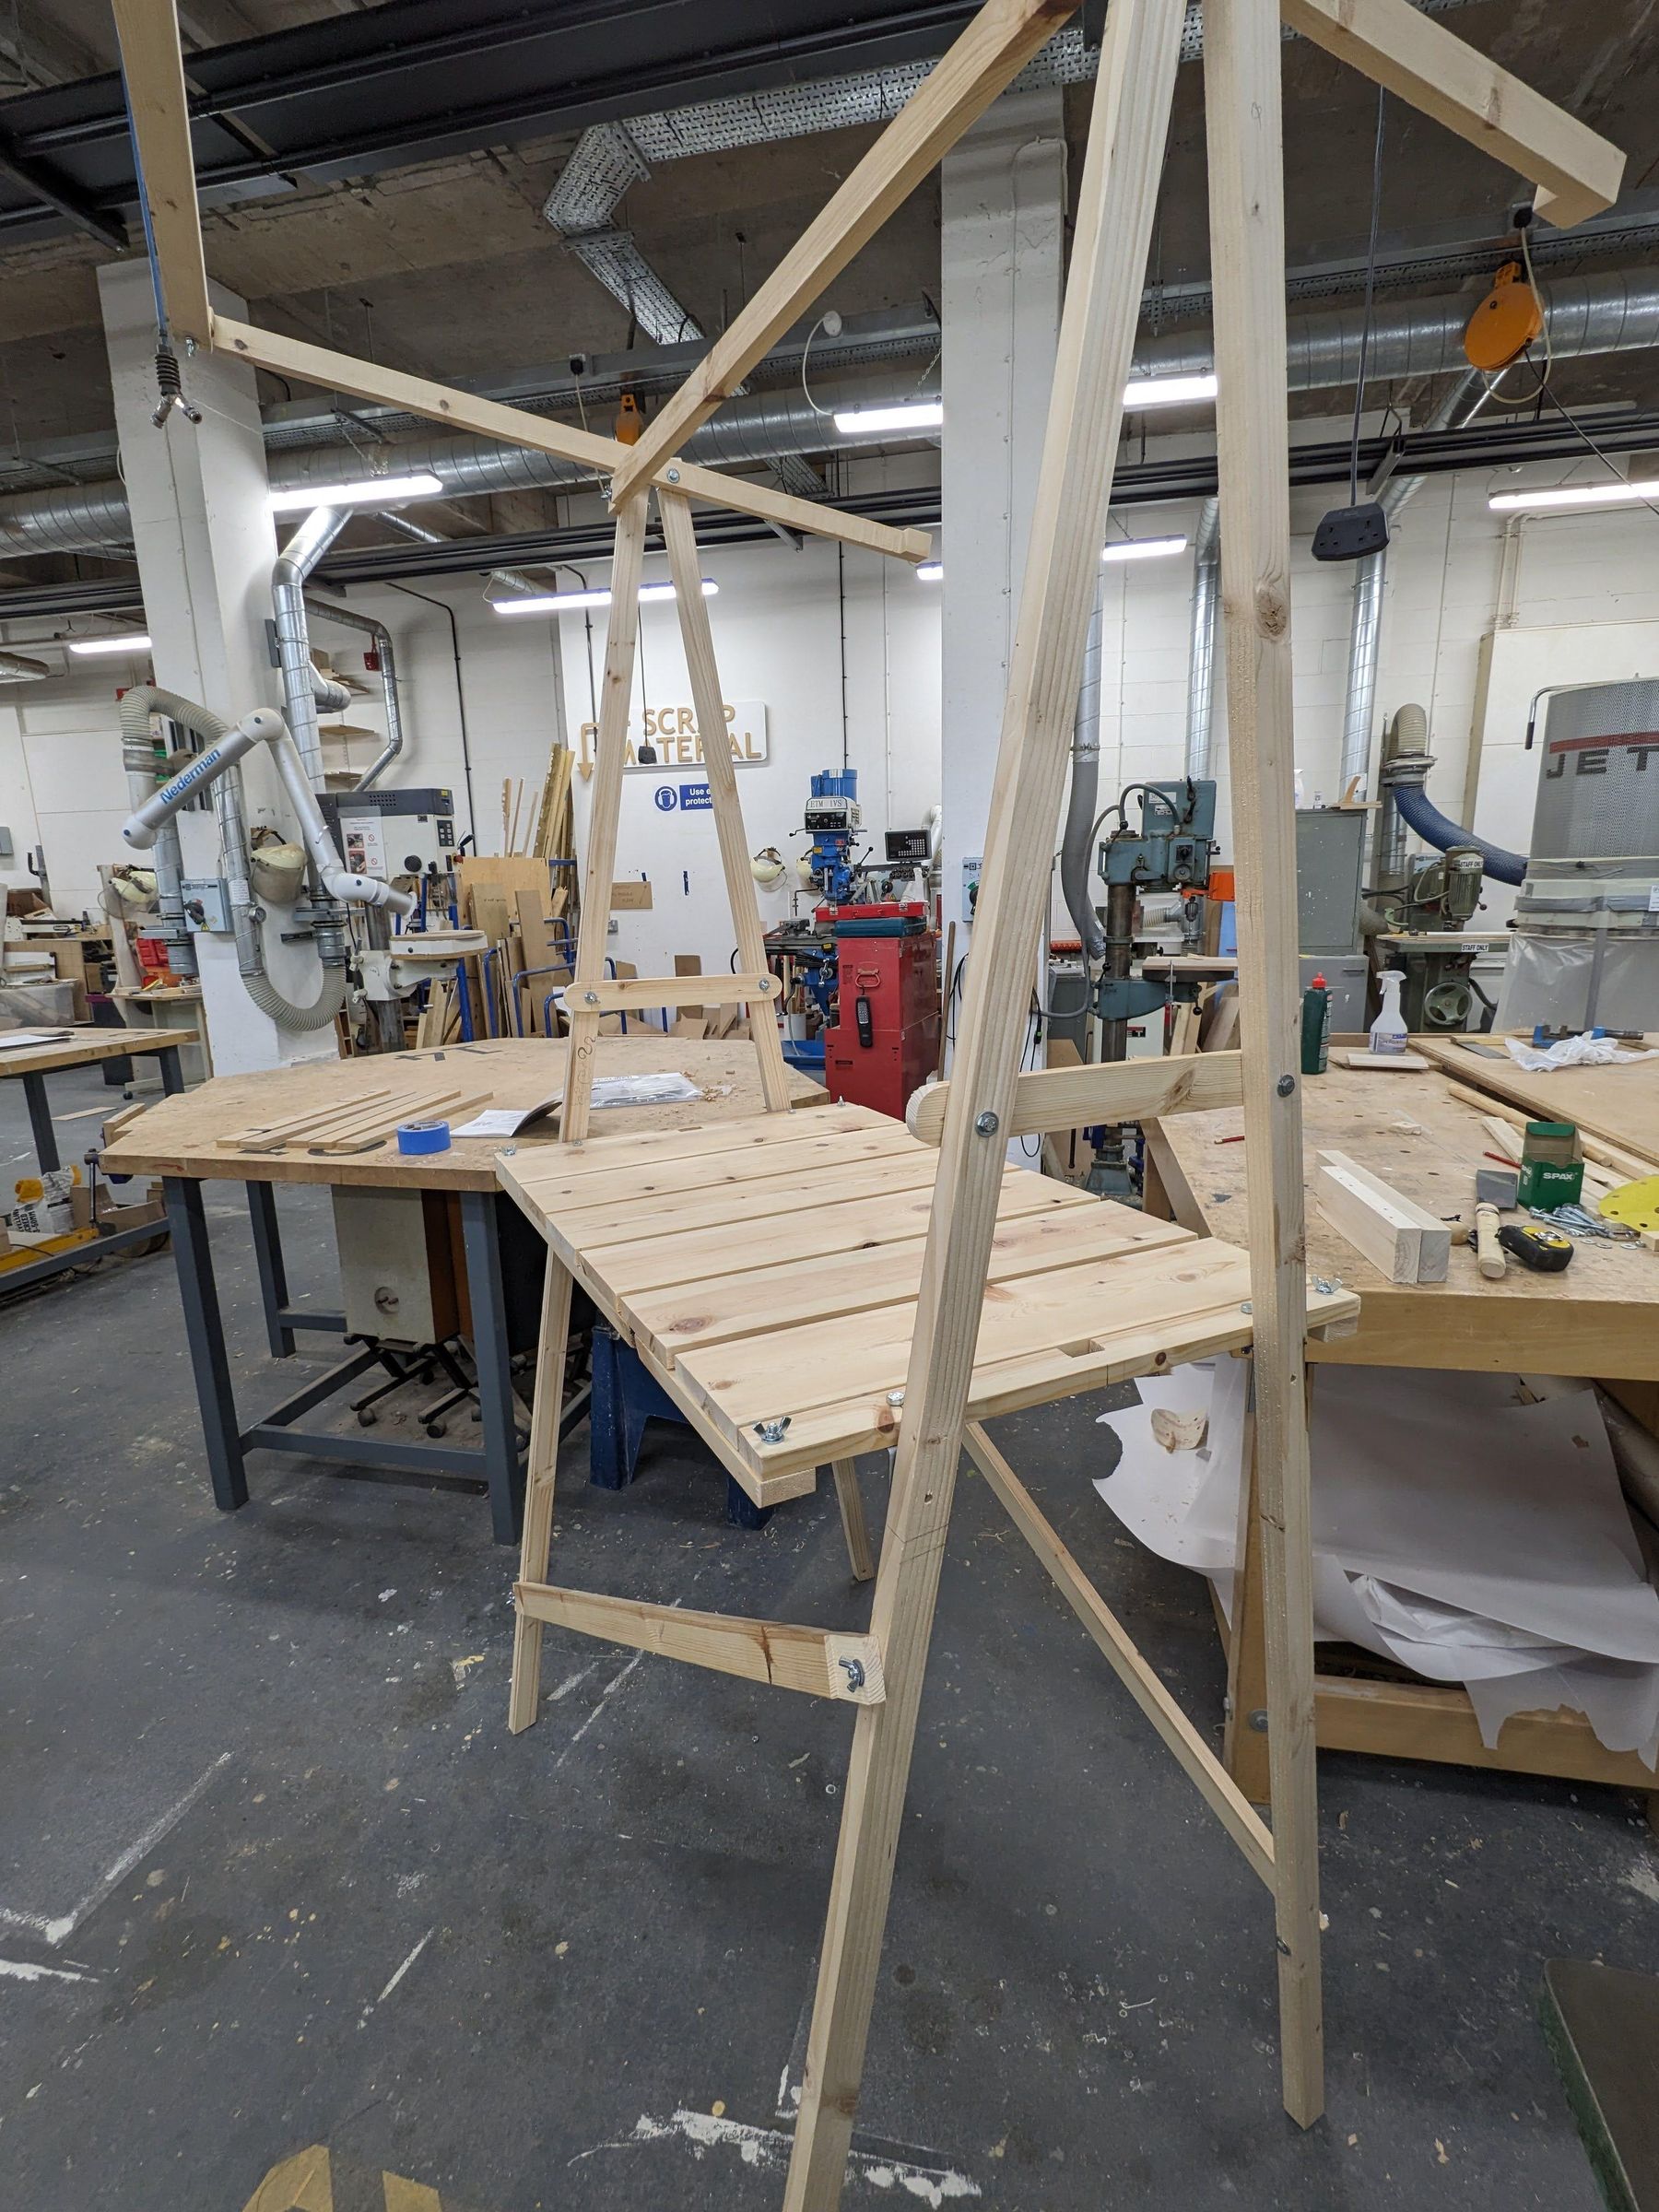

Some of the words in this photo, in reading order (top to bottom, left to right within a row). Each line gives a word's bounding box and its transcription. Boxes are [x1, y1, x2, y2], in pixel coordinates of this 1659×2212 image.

[642, 704, 735, 736] SCRP
[159, 748, 221, 805] Nederman
[1546, 745, 1659, 780] JET
[685, 797, 712, 807] protect
[1543, 1172, 1574, 1181] SPAX
